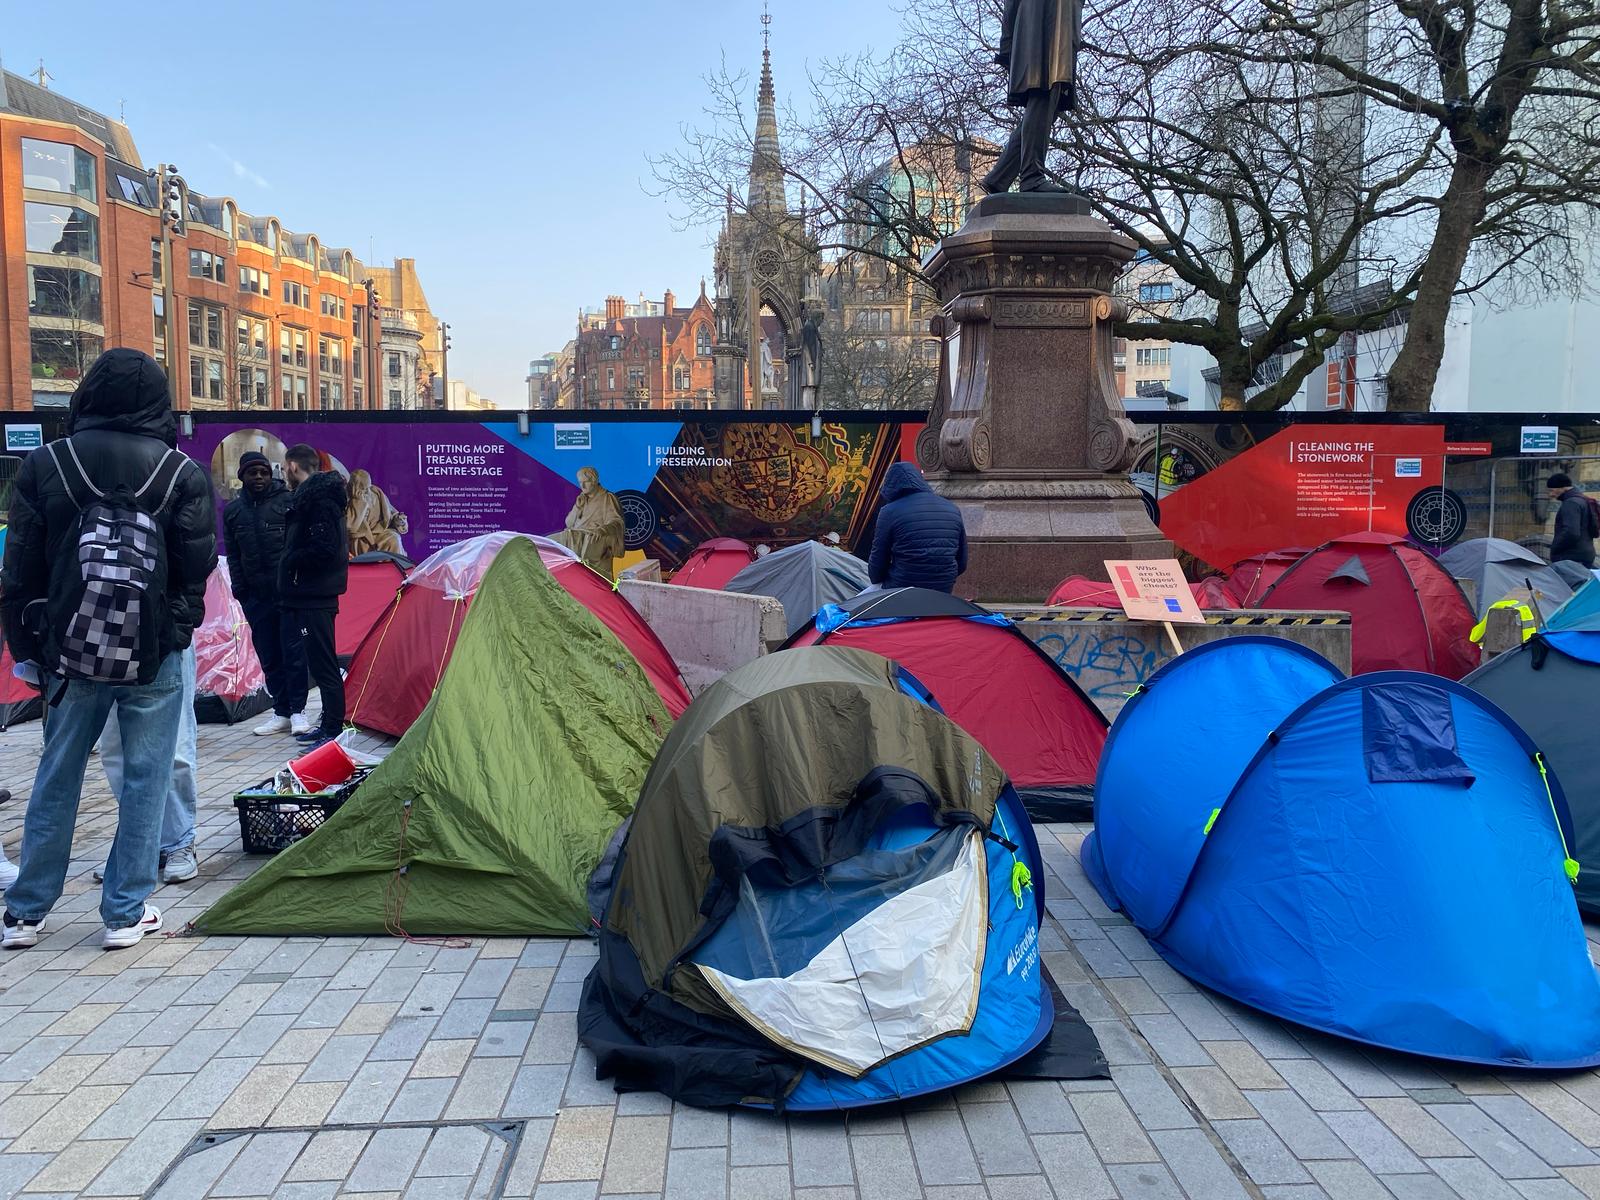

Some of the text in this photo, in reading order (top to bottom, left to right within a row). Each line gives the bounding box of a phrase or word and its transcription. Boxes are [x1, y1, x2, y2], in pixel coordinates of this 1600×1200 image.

[426, 444, 505, 453] PUTTING MORE
[655, 446, 705, 455] BUILDING
[1297, 442, 1375, 452] CLEANING THE
[426, 455, 486, 465] TREASURES
[655, 457, 732, 467] PRESERVATION
[1297, 453, 1365, 463] STONEWORK
[426, 466, 503, 476] CENTRE-STAGE
